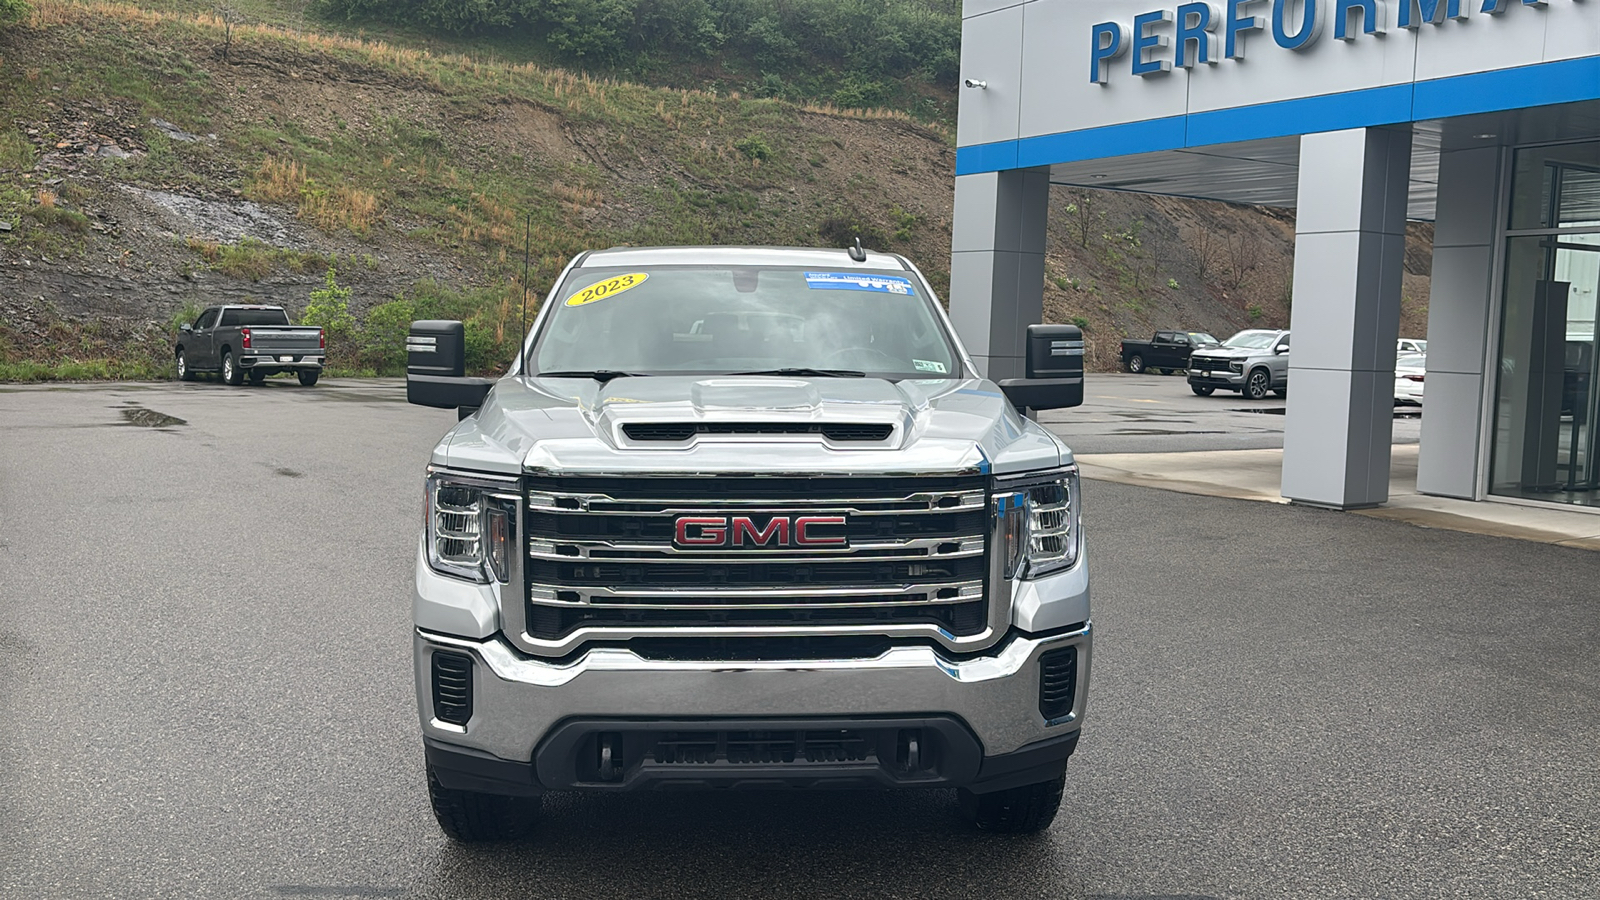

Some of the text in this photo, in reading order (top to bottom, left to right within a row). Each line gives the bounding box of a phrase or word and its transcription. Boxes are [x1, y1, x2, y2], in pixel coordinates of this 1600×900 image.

[1089, 0, 1549, 84] PERFOR
[581, 275, 634, 302] 2023
[674, 516, 848, 546] GMC
